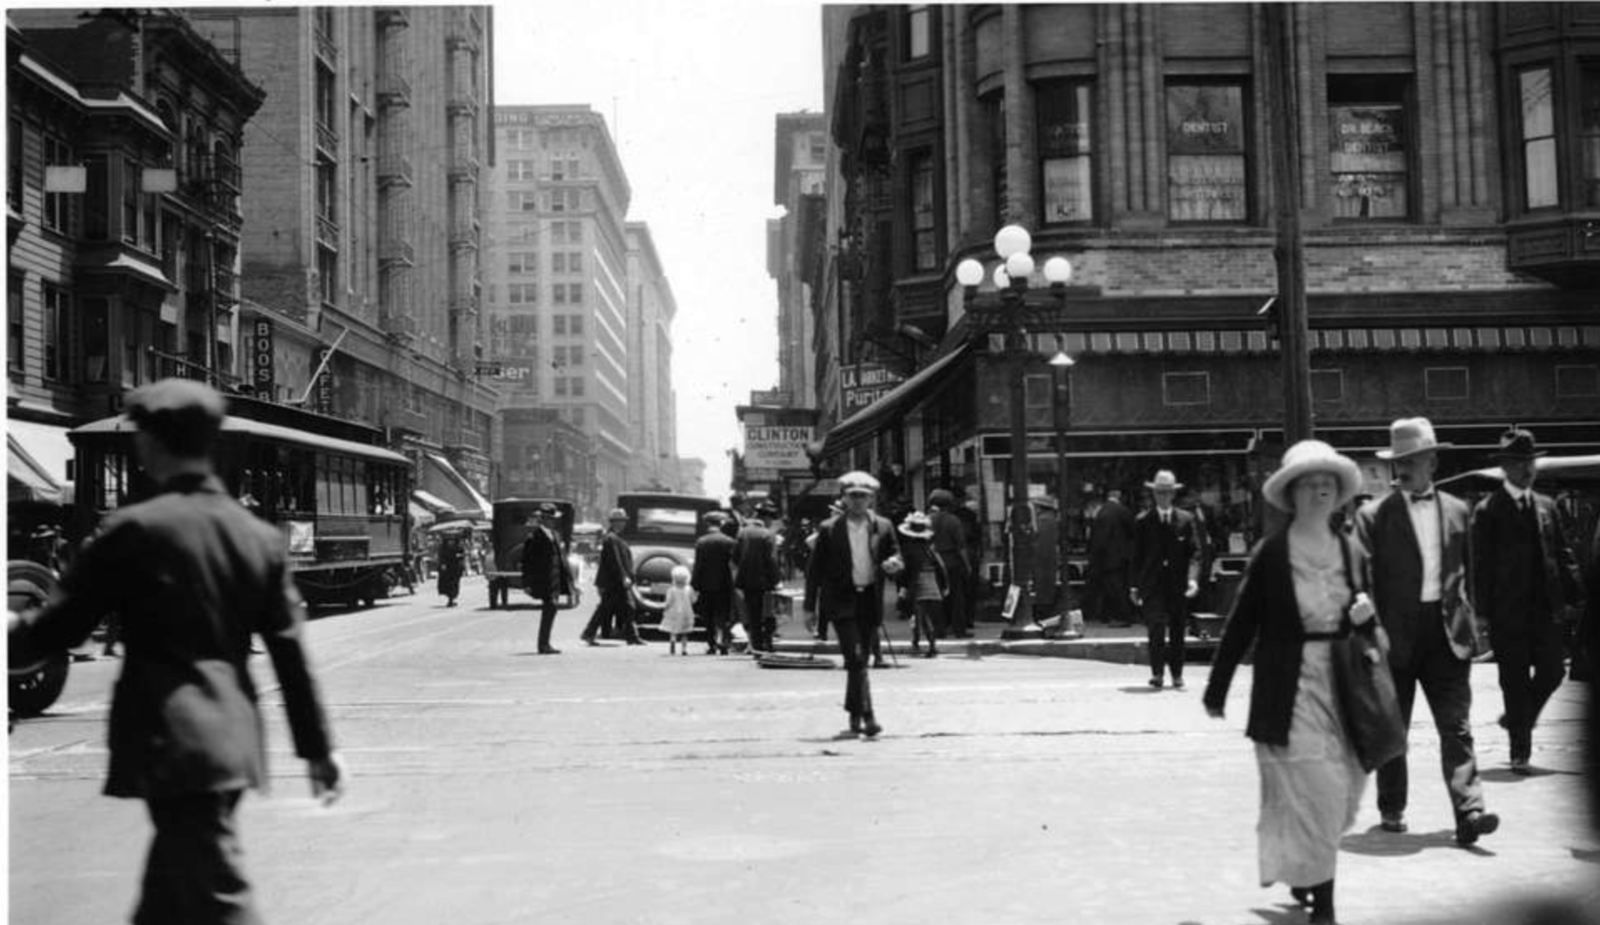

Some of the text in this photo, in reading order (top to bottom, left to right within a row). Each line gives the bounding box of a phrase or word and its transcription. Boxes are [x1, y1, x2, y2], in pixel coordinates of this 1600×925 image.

[1182, 122, 1227, 133] DENTIST
[257, 322, 270, 382] BOOS
[747, 428, 809, 441] CLINTON
